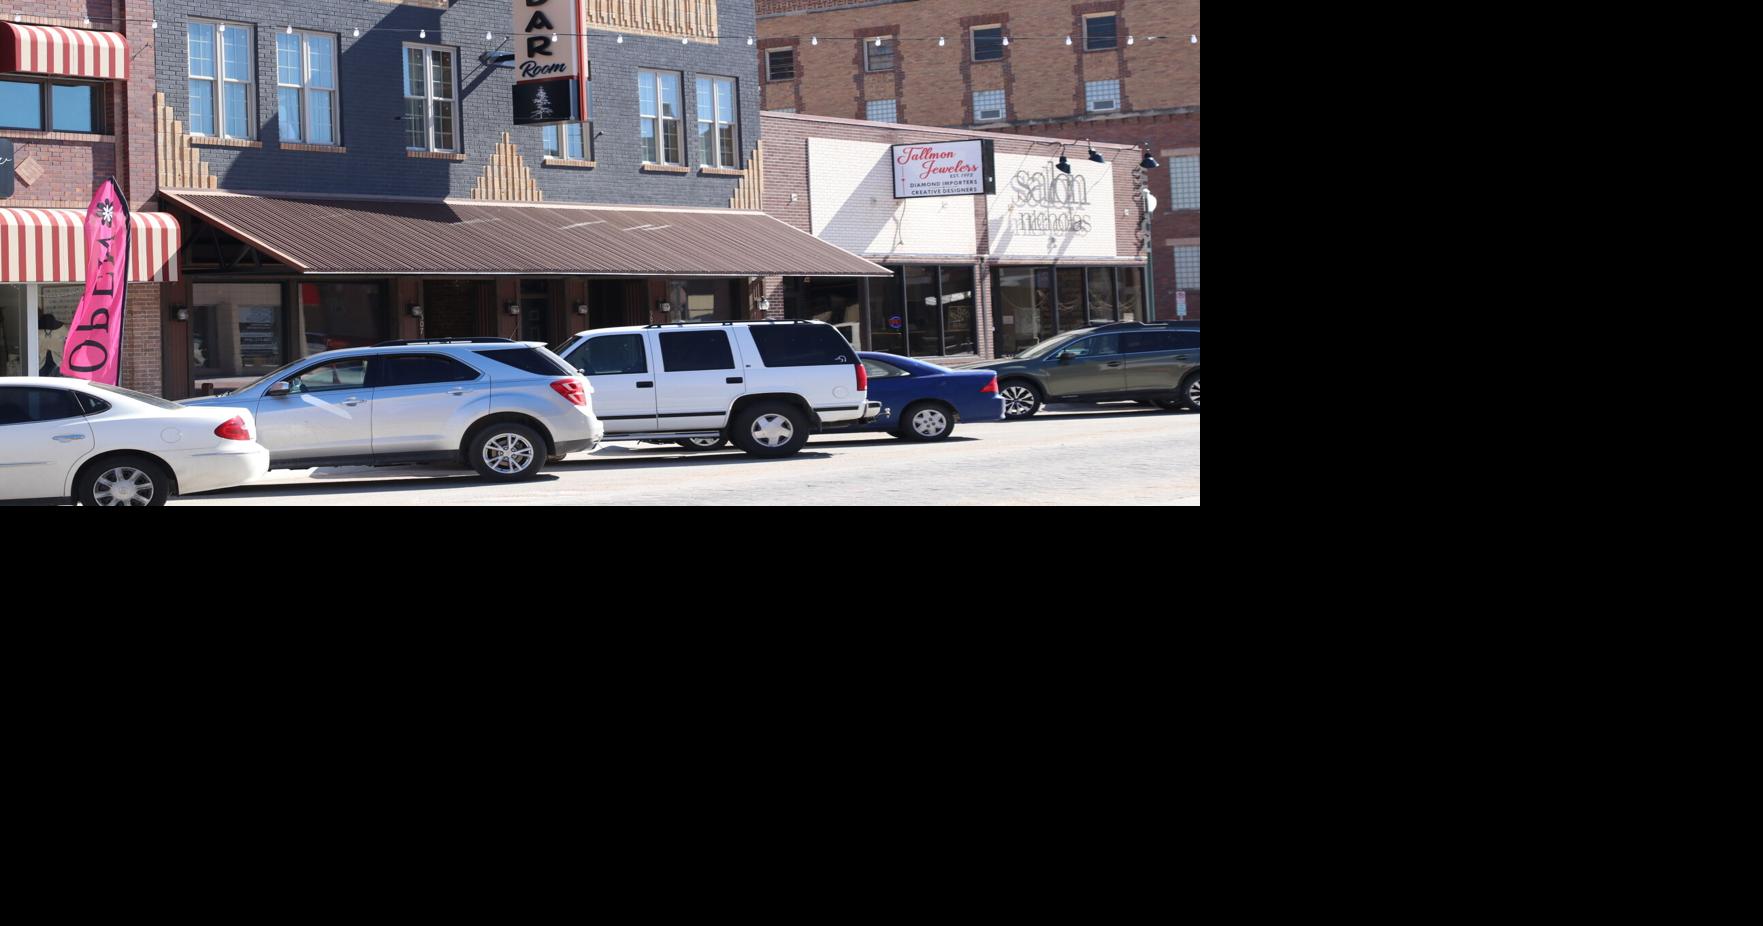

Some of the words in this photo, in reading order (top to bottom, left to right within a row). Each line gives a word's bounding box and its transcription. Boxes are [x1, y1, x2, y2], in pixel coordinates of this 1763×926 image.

[525, 0, 554, 58] AR
[519, 60, 567, 77] Room
[897, 146, 955, 165] Tallmon
[920, 160, 979, 179] Jewelers
[911, 188, 941, 196] CREATIVE
[942, 186, 977, 194] DESIGNERS
[1016, 160, 1091, 205] salon
